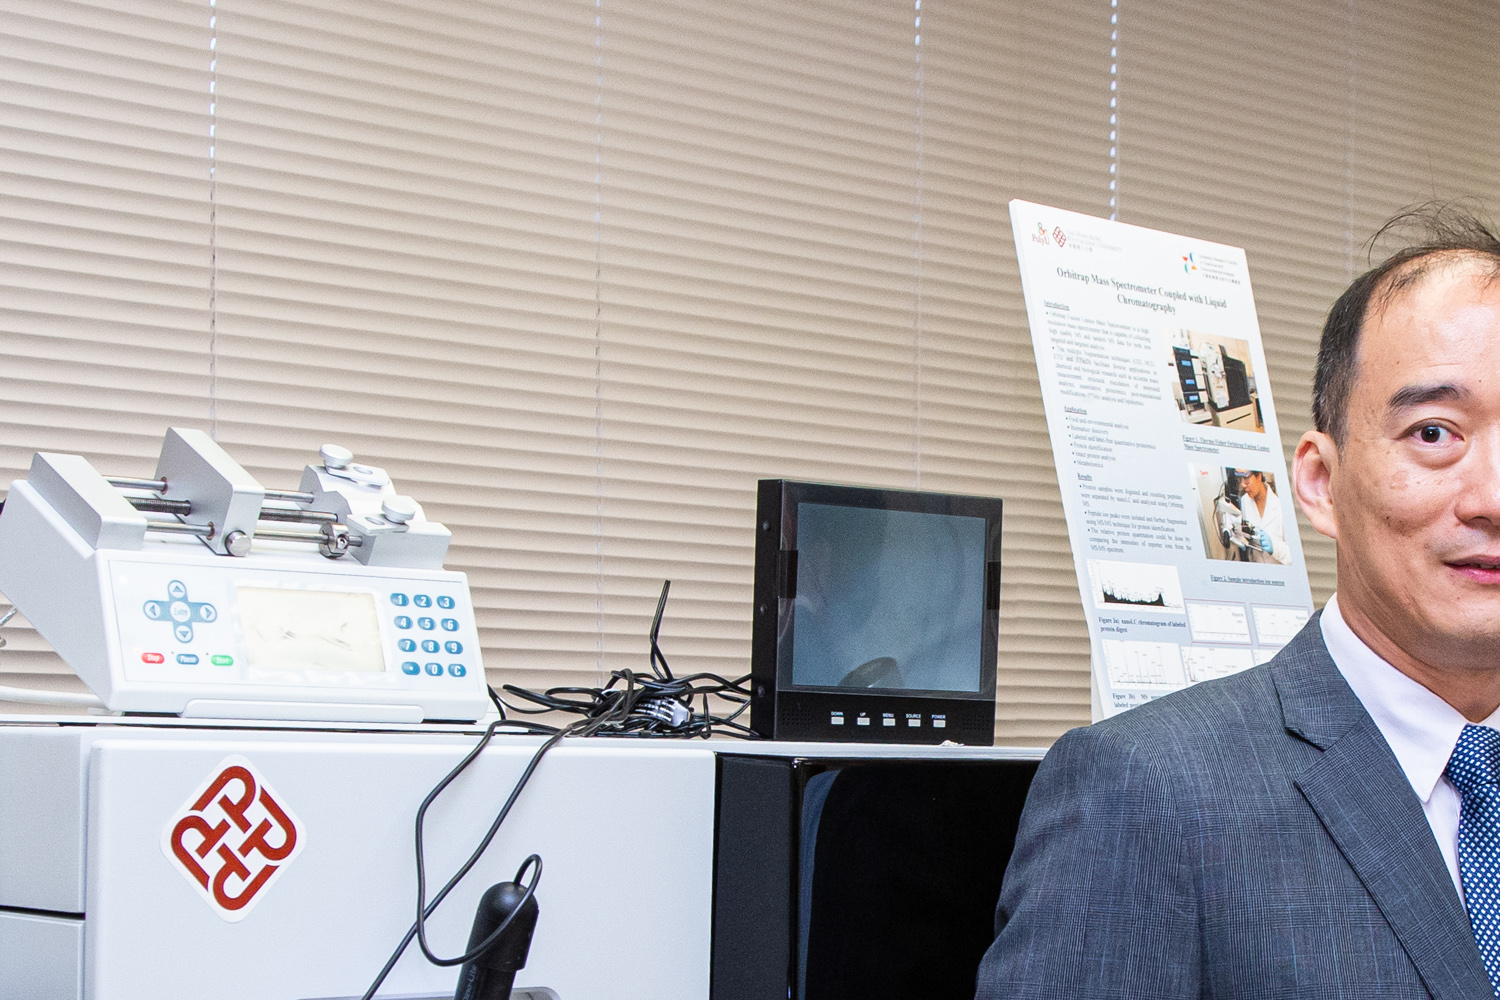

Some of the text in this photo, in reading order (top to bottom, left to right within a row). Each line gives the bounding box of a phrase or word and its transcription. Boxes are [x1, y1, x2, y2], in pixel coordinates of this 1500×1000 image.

[1057, 266, 1227, 310] Orbitrap Mass Spectrometer Coupled with Liquid
[1117, 293, 1176, 316] Chromatography
[397, 595, 450, 608] 1 2 3
[400, 617, 454, 630] 4 5 6
[405, 640, 458, 653] 7 8 9
[431, 664, 438, 675] 0
[454, 665, 461, 676] C
